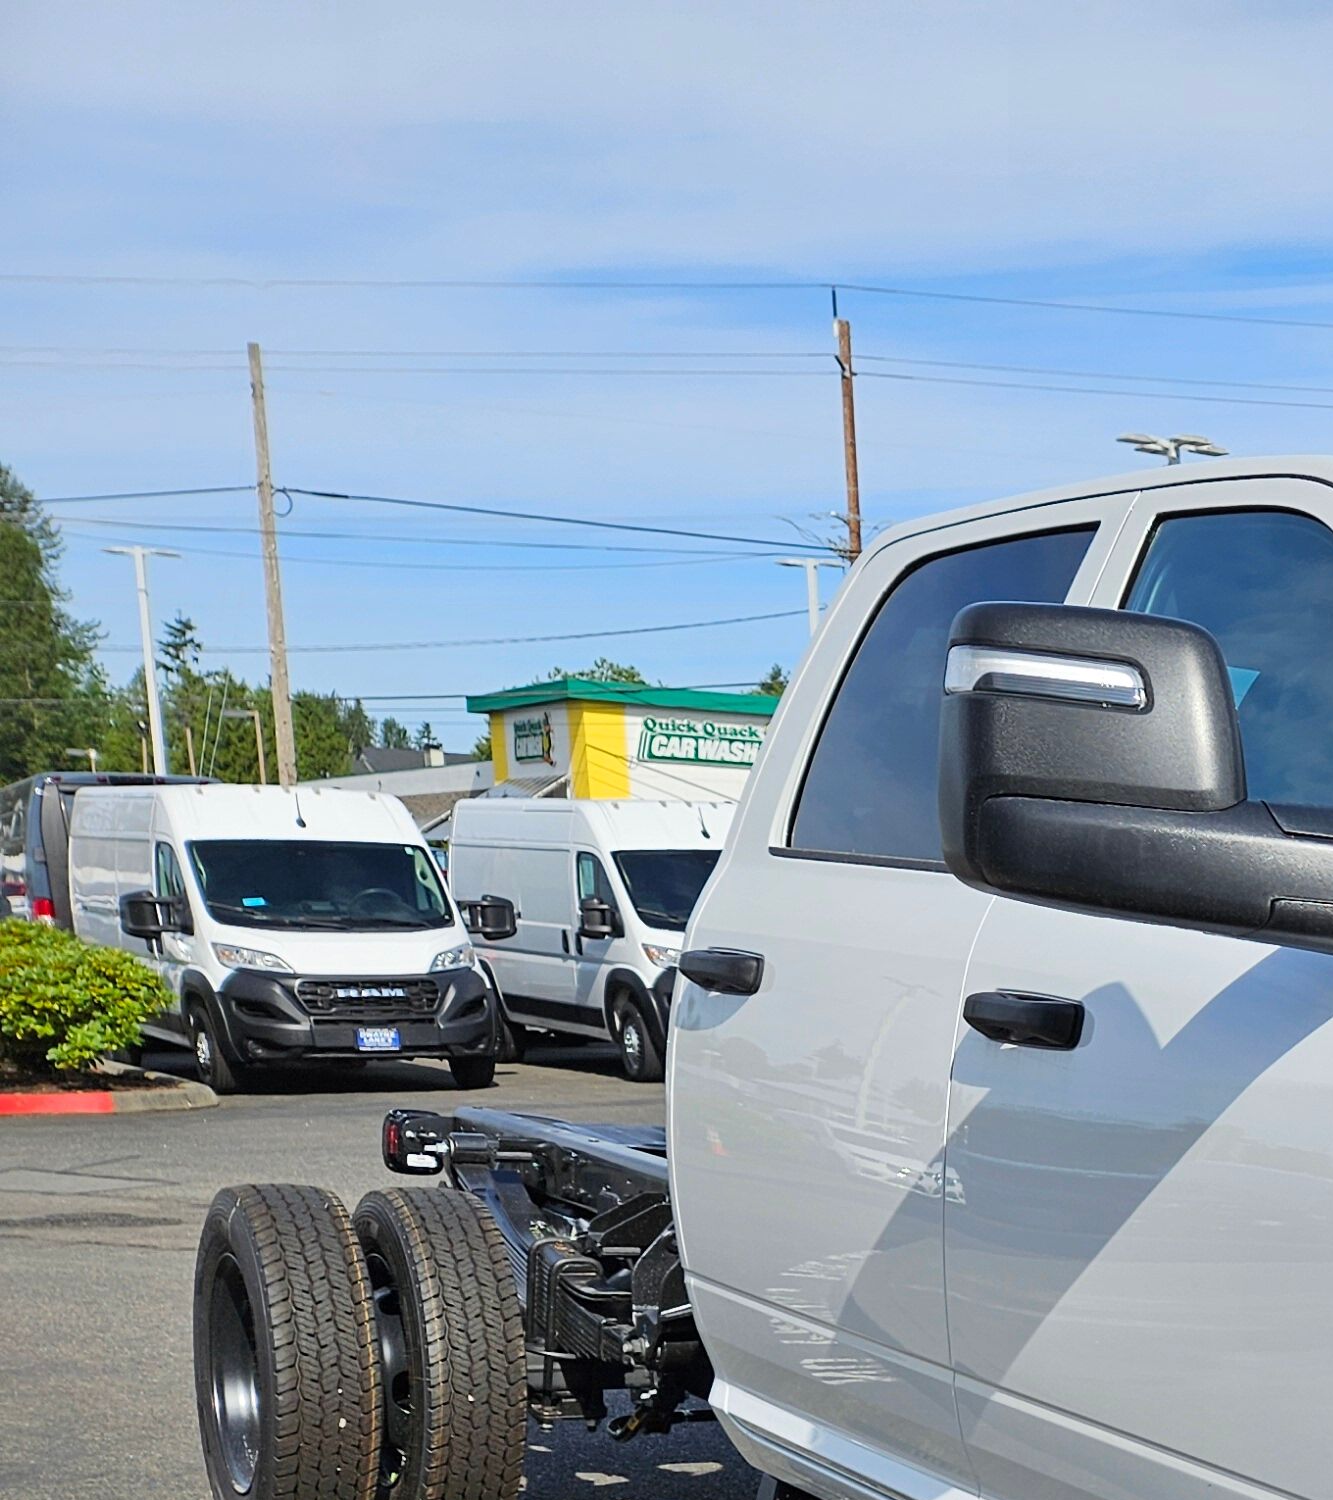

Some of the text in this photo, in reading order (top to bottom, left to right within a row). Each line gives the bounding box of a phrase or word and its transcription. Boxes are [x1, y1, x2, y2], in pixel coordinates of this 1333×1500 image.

[643, 717, 760, 738] Quick Quack
[651, 734, 760, 763] CAR WASH
[336, 987, 406, 998] RAM
